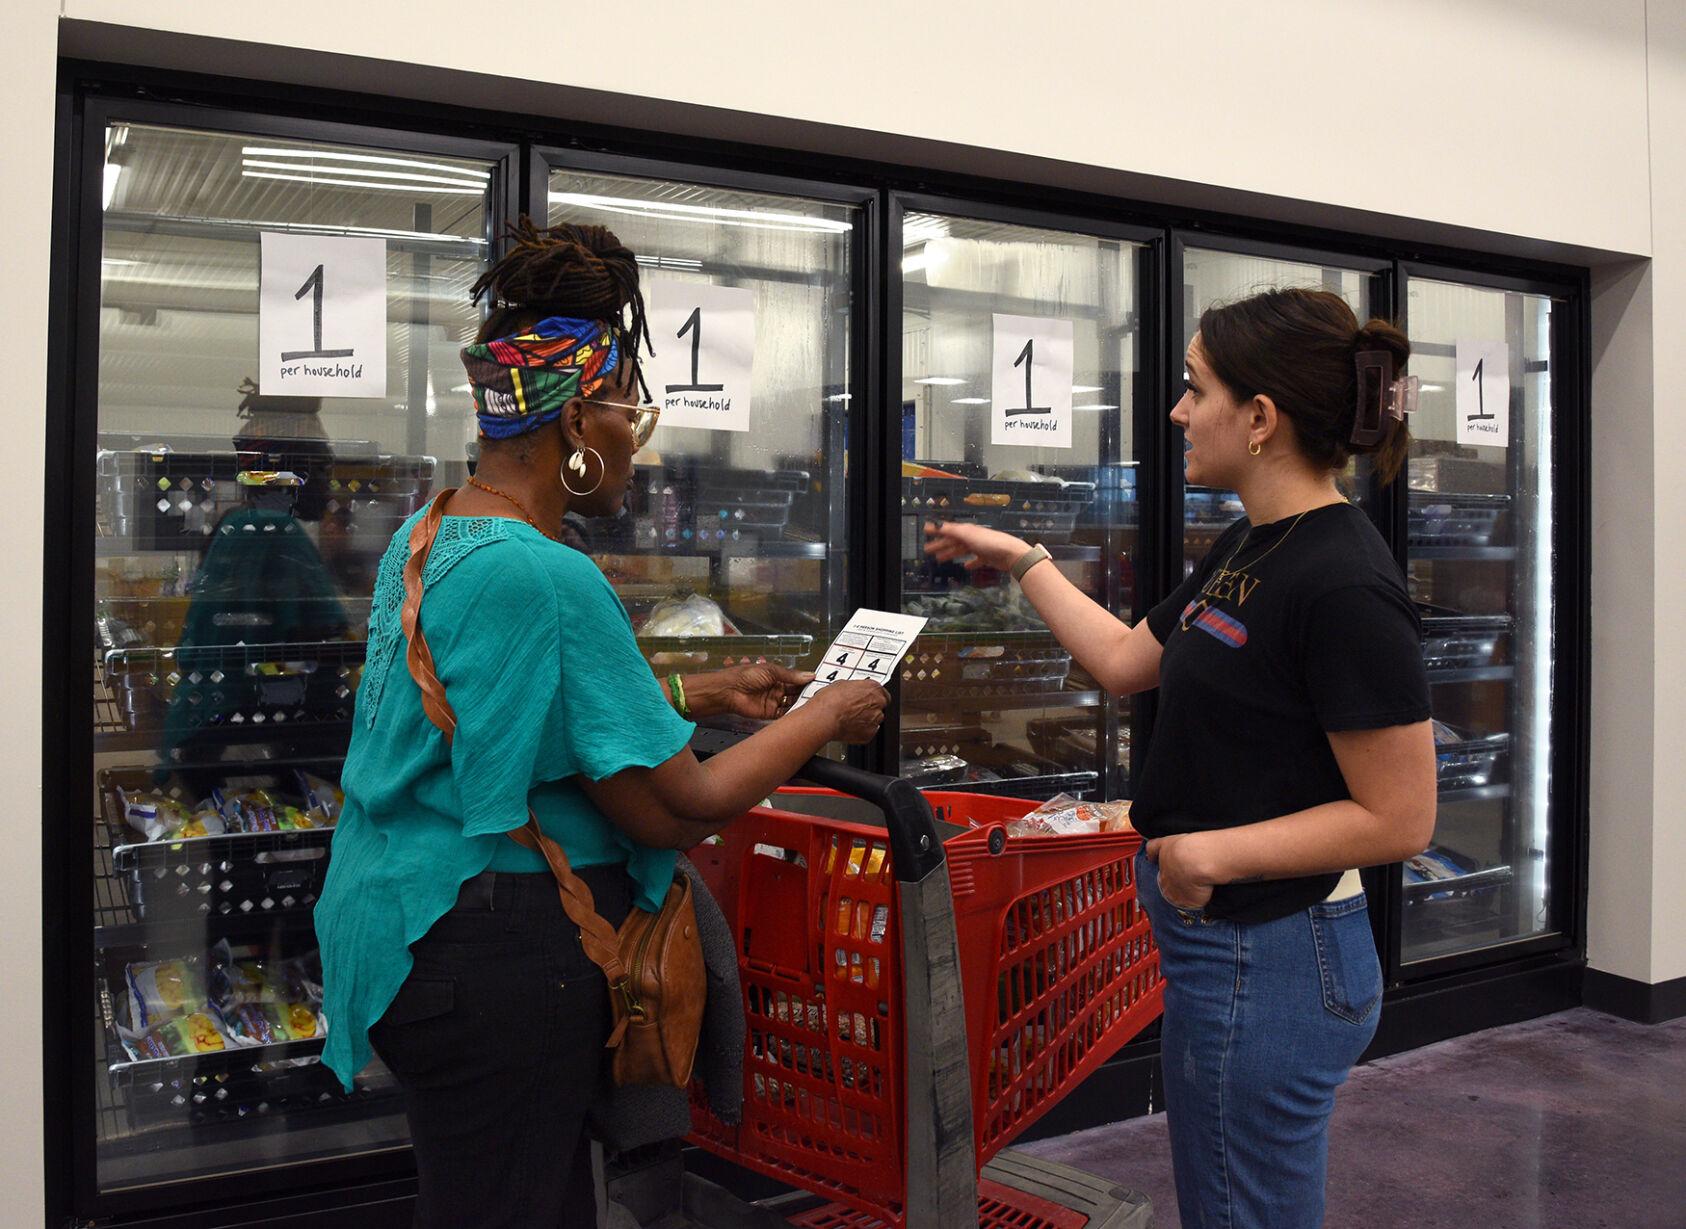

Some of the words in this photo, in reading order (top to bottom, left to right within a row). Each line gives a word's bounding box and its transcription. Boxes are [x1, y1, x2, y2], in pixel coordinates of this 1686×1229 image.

[281, 264, 354, 362] 1
[665, 307, 724, 394] 1
[280, 365, 301, 379] per
[303, 364, 363, 379] household
[1005, 338, 1051, 417] 1
[1467, 358, 1495, 421] 1
[665, 397, 681, 409] per
[683, 397, 731, 411] household
[1005, 420, 1018, 431] per
[1019, 419, 1058, 431] household
[1467, 424, 1476, 432] per
[836, 653, 848, 665] 4
[868, 659, 880, 670] 4
[826, 671, 838, 681] 4
